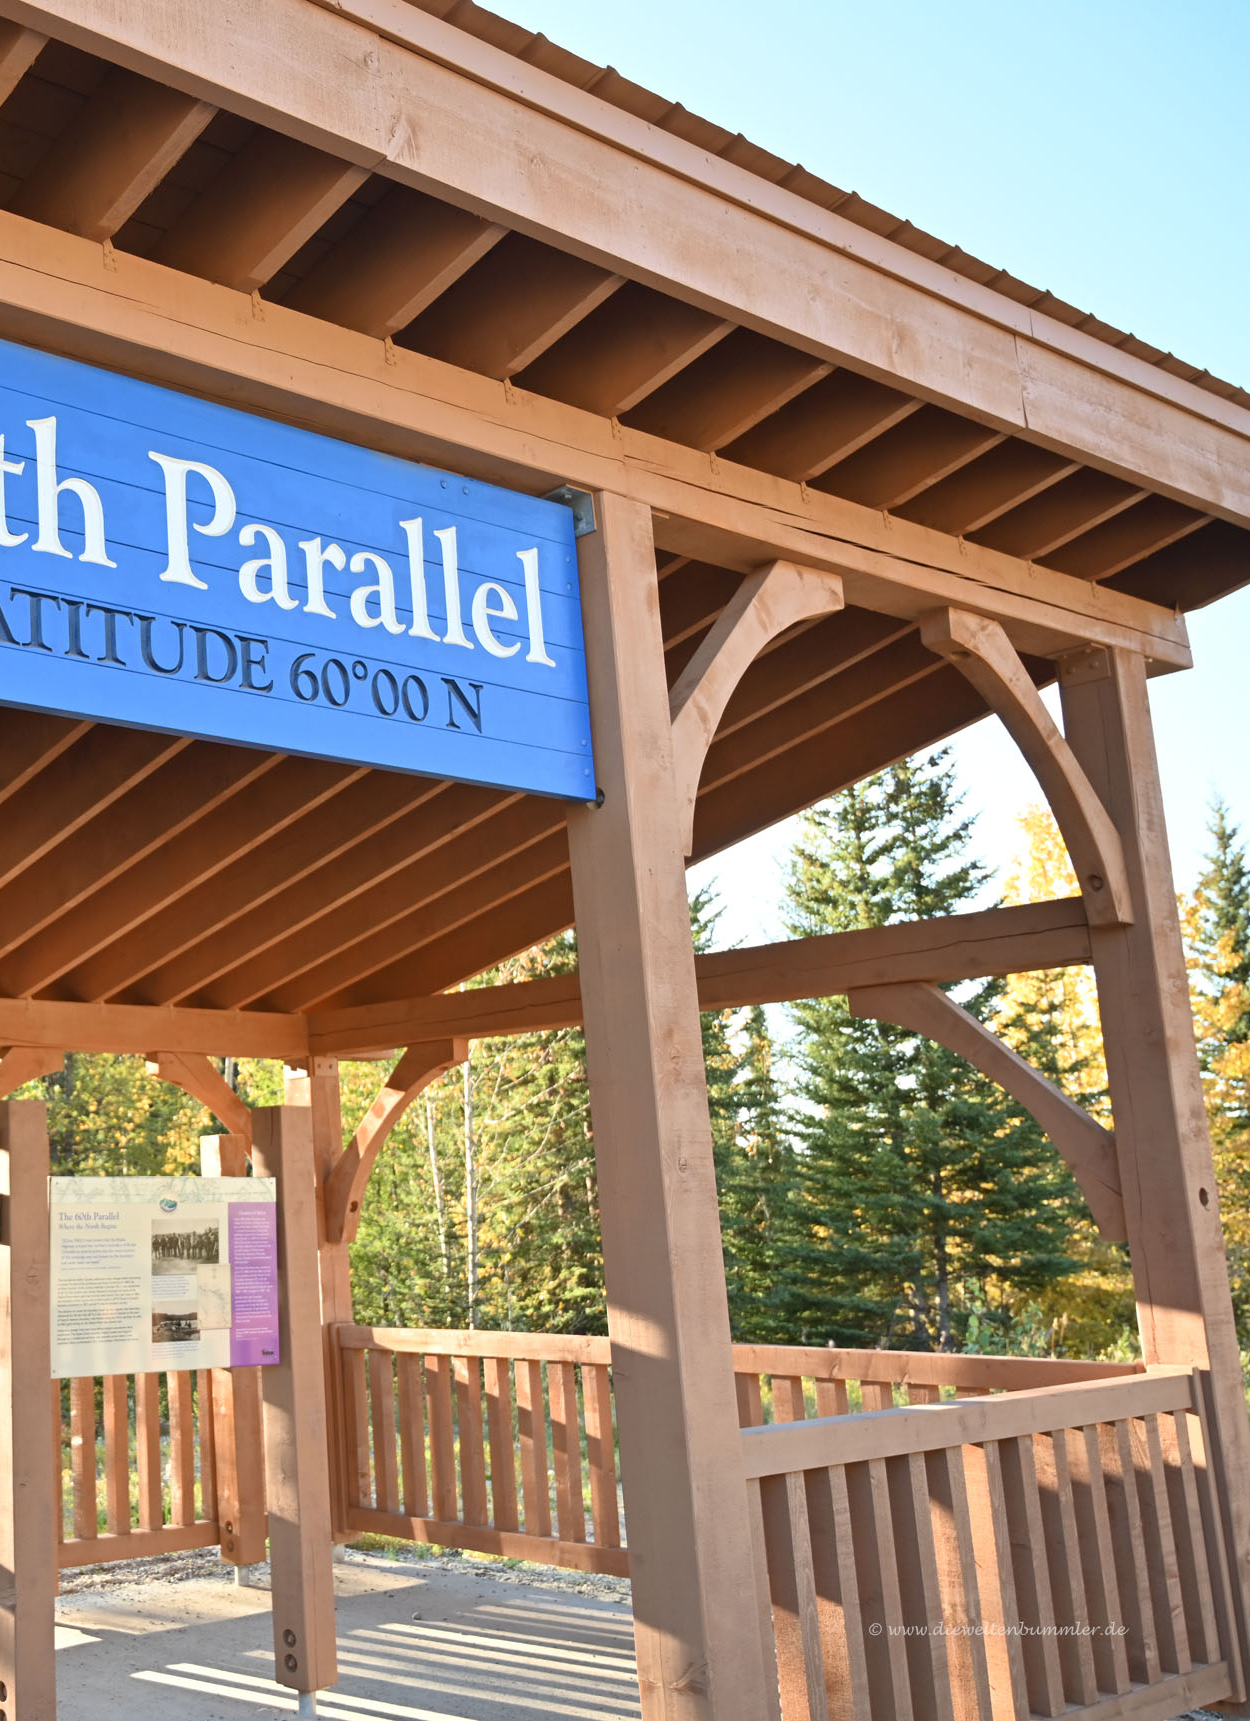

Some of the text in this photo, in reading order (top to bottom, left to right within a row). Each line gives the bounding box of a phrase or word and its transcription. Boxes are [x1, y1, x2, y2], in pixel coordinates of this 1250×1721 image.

[148, 450, 556, 667] Parallel
[445, 677, 484, 734] N
[58, 1211, 119, 1221] The 60th Parallel
